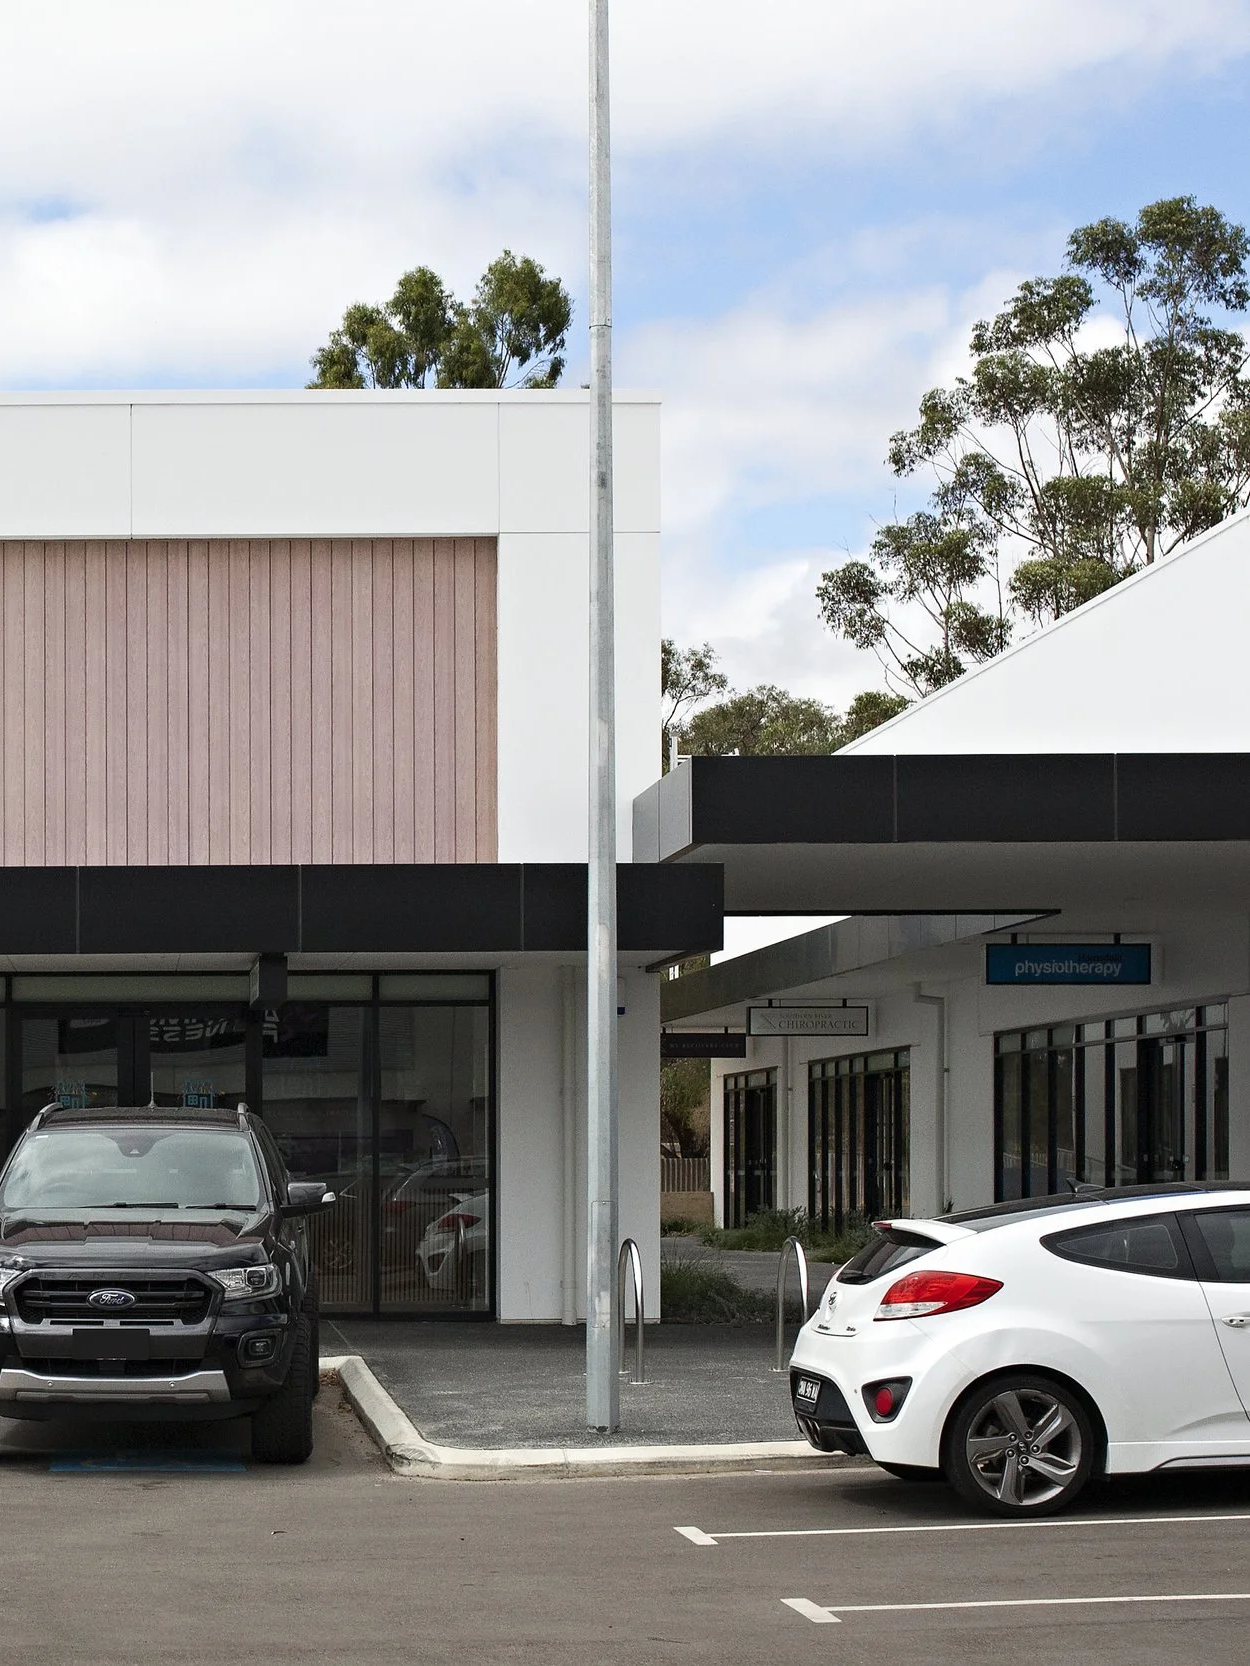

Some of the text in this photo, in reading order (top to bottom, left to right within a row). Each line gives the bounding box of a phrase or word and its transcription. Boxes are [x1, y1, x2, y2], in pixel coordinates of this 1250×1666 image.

[1015, 959, 1122, 977] physiotherapy
[778, 1020, 860, 1029] CHIROPRACTIC
[100, 1293, 125, 1305] Ford
